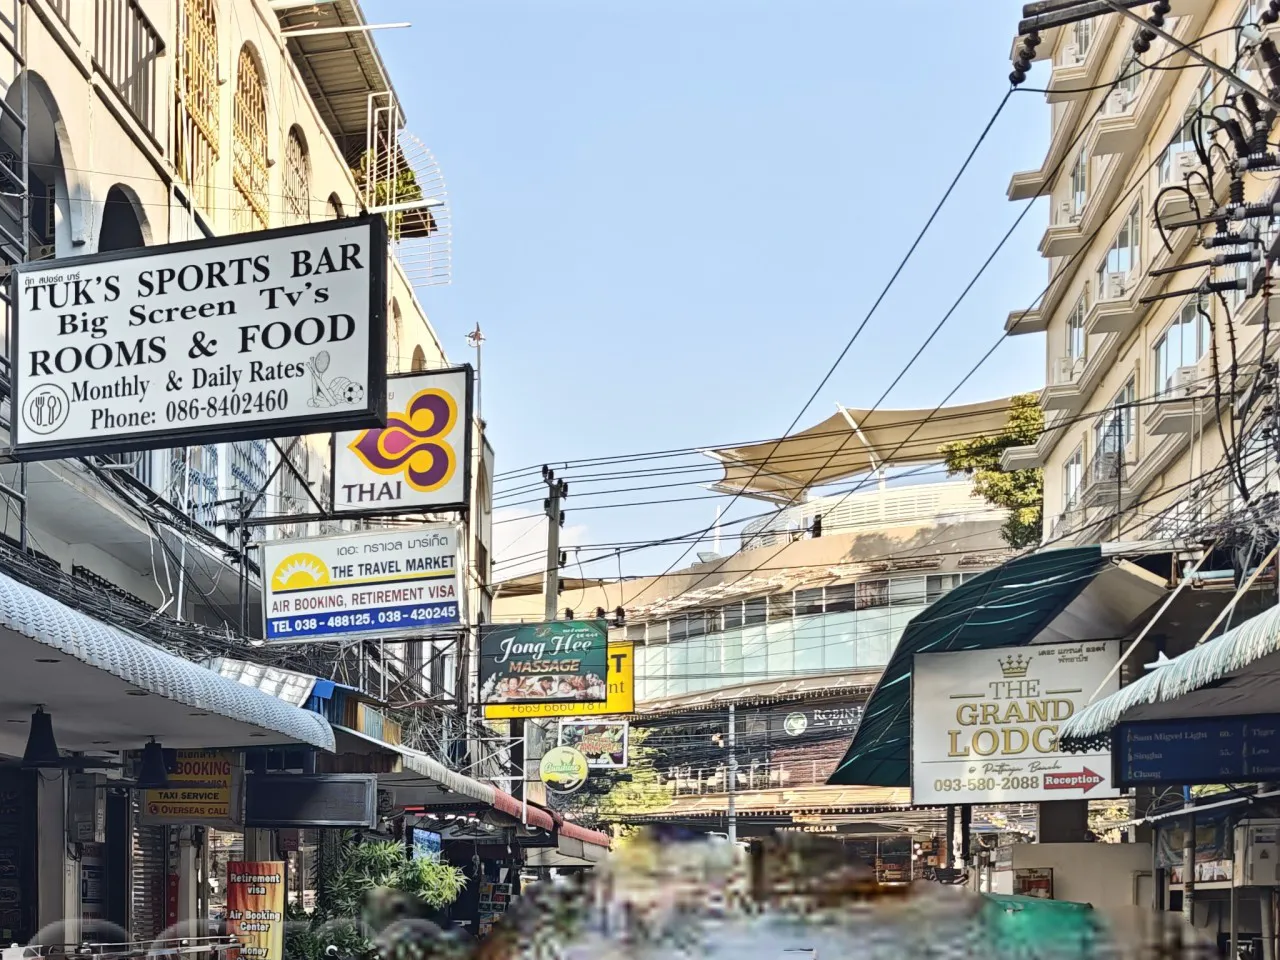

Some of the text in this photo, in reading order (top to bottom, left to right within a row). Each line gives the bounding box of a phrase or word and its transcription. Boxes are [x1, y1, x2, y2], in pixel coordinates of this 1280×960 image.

[25, 243, 364, 312] TUK'S SPORTS BAR
[58, 282, 329, 339] Big Screen Tv's
[29, 313, 356, 377] ROOMS & FOOD
[71, 360, 305, 403] Monthly & Daily Rates
[90, 389, 288, 430] Phone: 086-8402460
[342, 480, 402, 504] THAI
[337, 533, 449, 556] เดอะ ทราเวล มาร์เก็ต
[332, 554, 455, 579] THE TRAVEL MARKET
[272, 584, 455, 613] AIR BOOKING, RETIREMENT VISA
[272, 620, 292, 633] TEL
[494, 633, 592, 664] Jong Hee
[508, 658, 582, 673] MASSAGE
[989, 678, 1041, 700] THE
[956, 698, 1075, 728] GRAND
[948, 723, 1061, 758] LODG
[176, 761, 231, 775] BOOKING
[934, 774, 1100, 792] 093-580-2088 Reception
[158, 791, 220, 800] TAXI SERVICE
[208, 807, 228, 815] CALL
[804, 825, 837, 833] CELLAR
[230, 873, 280, 884] Retirement
[247, 885, 266, 895] visa
[229, 909, 281, 922] Air Booking
[240, 922, 270, 932] Center
